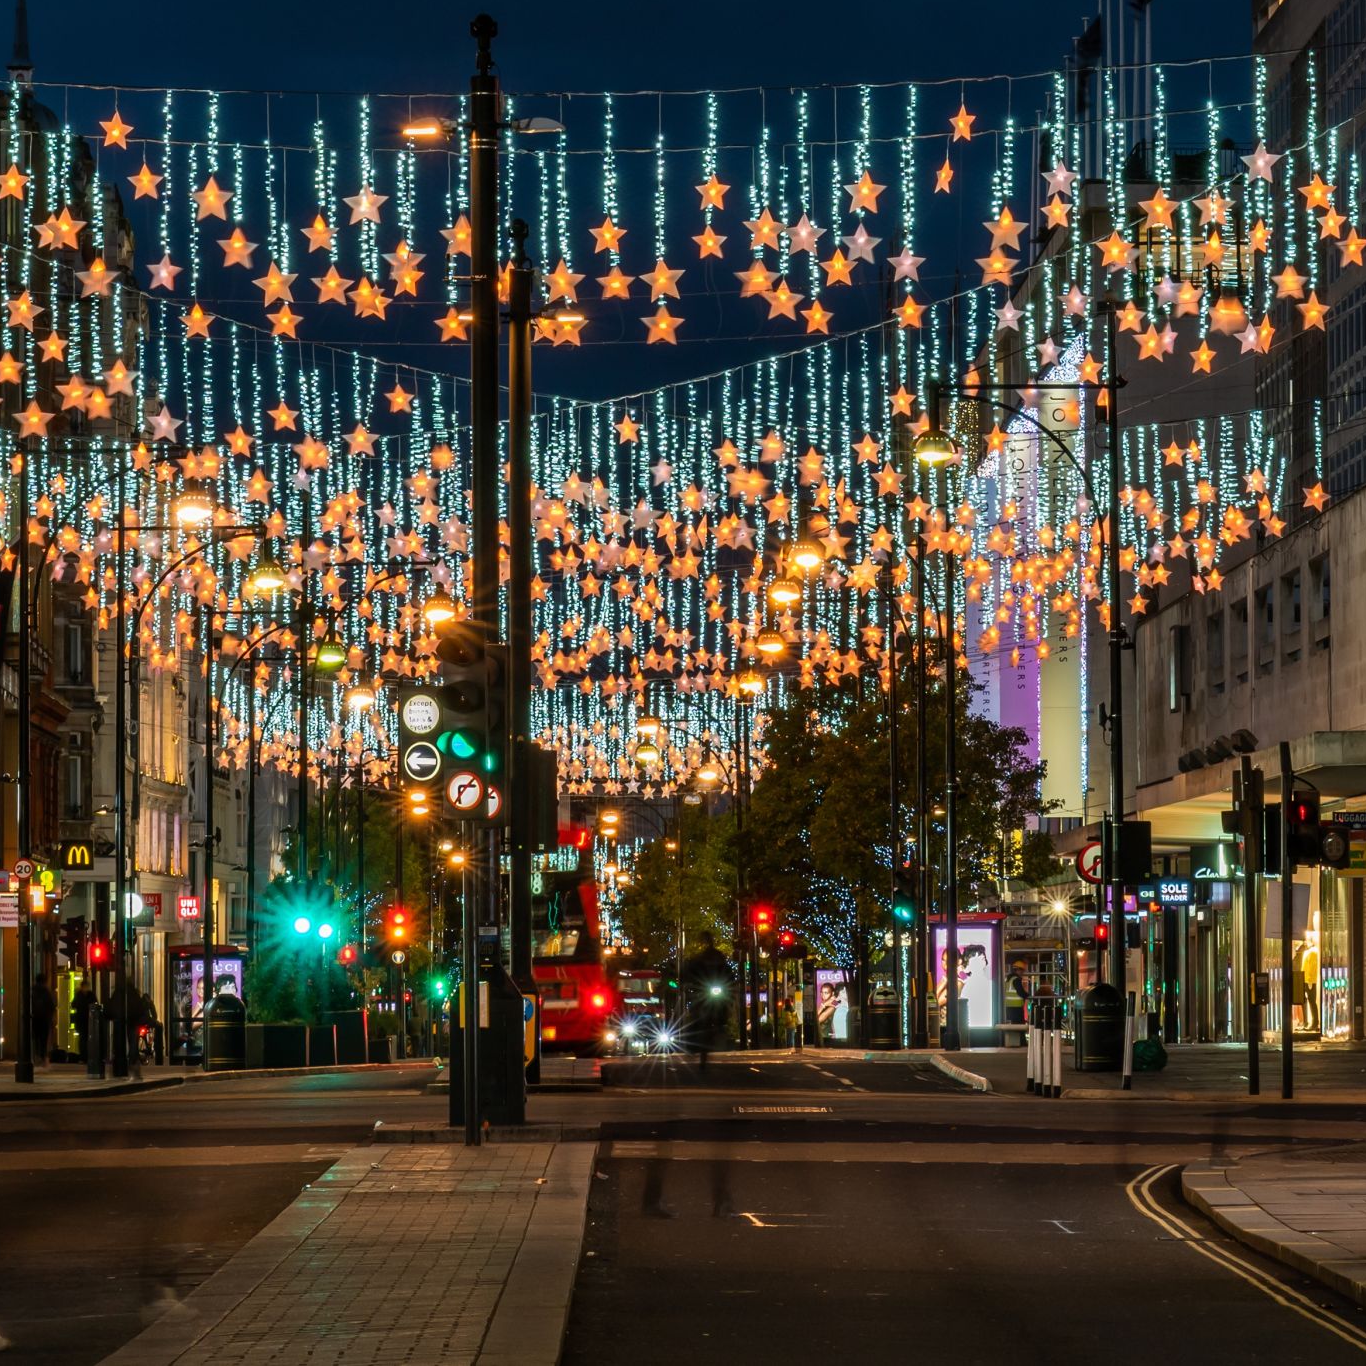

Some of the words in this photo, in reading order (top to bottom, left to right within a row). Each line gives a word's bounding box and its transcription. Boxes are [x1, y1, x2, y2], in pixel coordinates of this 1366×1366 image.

[16, 864, 31, 874] 20
[1161, 883, 1188, 894] SOLE
[180, 899, 197, 908] UNI
[180, 908, 198, 917] QLO
[195, 962, 239, 972] GCCI
[819, 973, 842, 981] GUC
